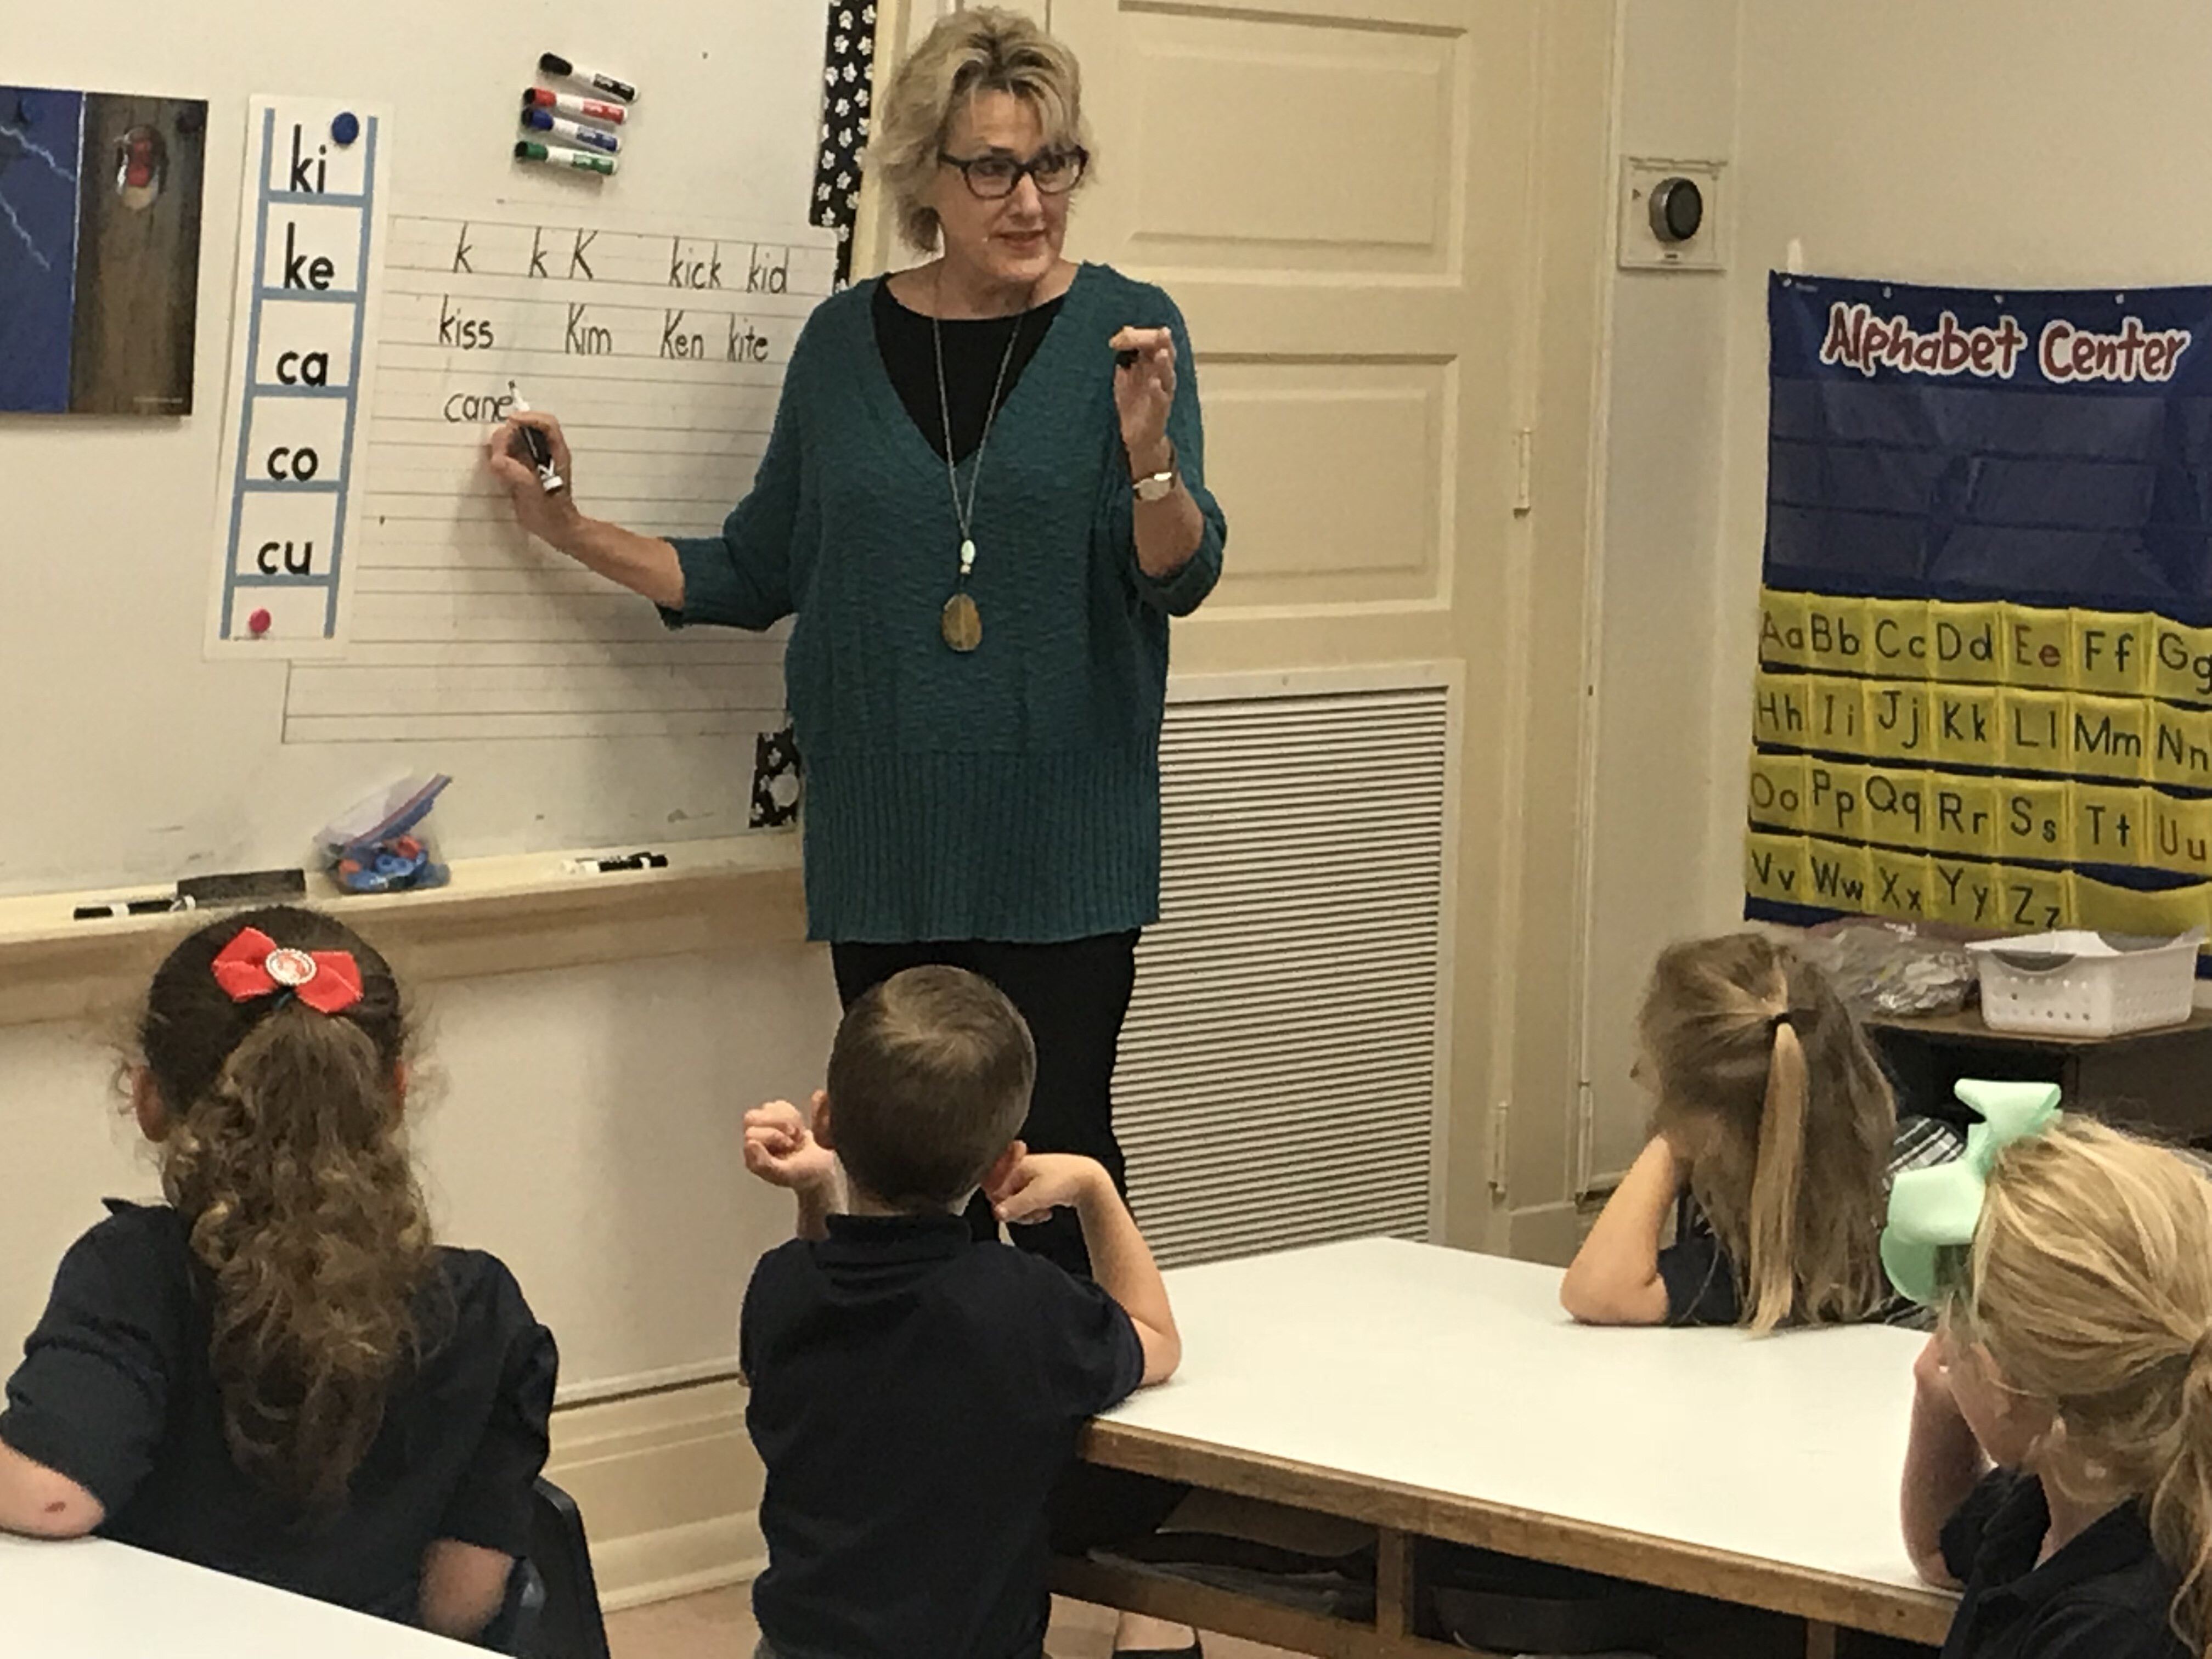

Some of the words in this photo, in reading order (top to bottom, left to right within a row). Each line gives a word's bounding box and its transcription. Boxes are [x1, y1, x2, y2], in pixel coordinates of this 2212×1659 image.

[290, 124, 327, 194] ki
[283, 222, 335, 291] ke
[453, 221, 472, 273] k
[668, 236, 721, 290] kick
[746, 243, 790, 294] kid
[439, 293, 494, 349] kiss
[565, 302, 612, 356] Kim
[660, 308, 704, 360] Ken
[727, 312, 769, 362] kite
[1822, 304, 2025, 375] Alphabet
[2042, 318, 2191, 381] Center
[276, 351, 329, 387] ca
[443, 392, 514, 422] cane
[267, 447, 318, 482] co
[257, 541, 313, 575] cu
